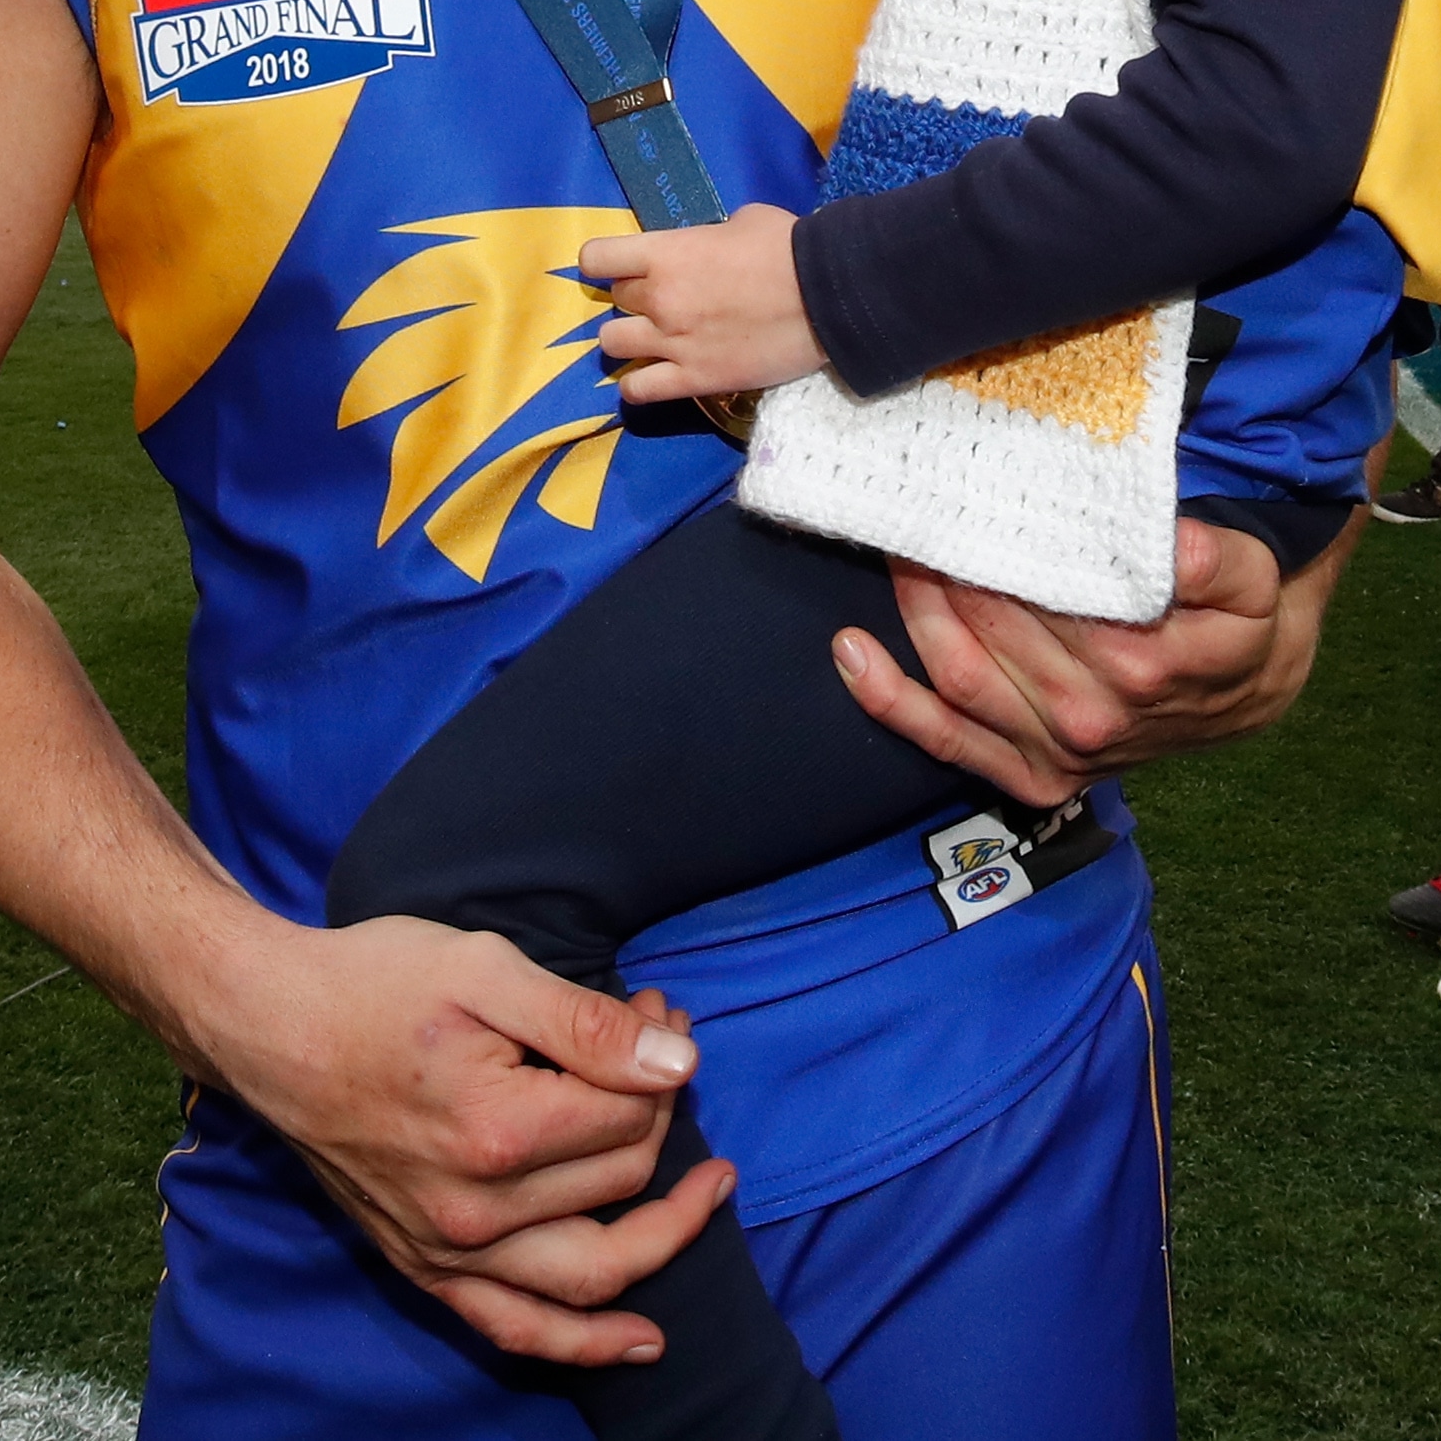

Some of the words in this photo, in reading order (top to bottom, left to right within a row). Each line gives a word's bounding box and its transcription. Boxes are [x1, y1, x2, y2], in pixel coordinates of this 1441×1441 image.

[148, 3, 269, 79] GRAND
[571, 1, 627, 88] PREMIERS
[246, 47, 310, 88] 2018
[614, 91, 645, 113] 2018
[966, 871, 1008, 900] AFL
